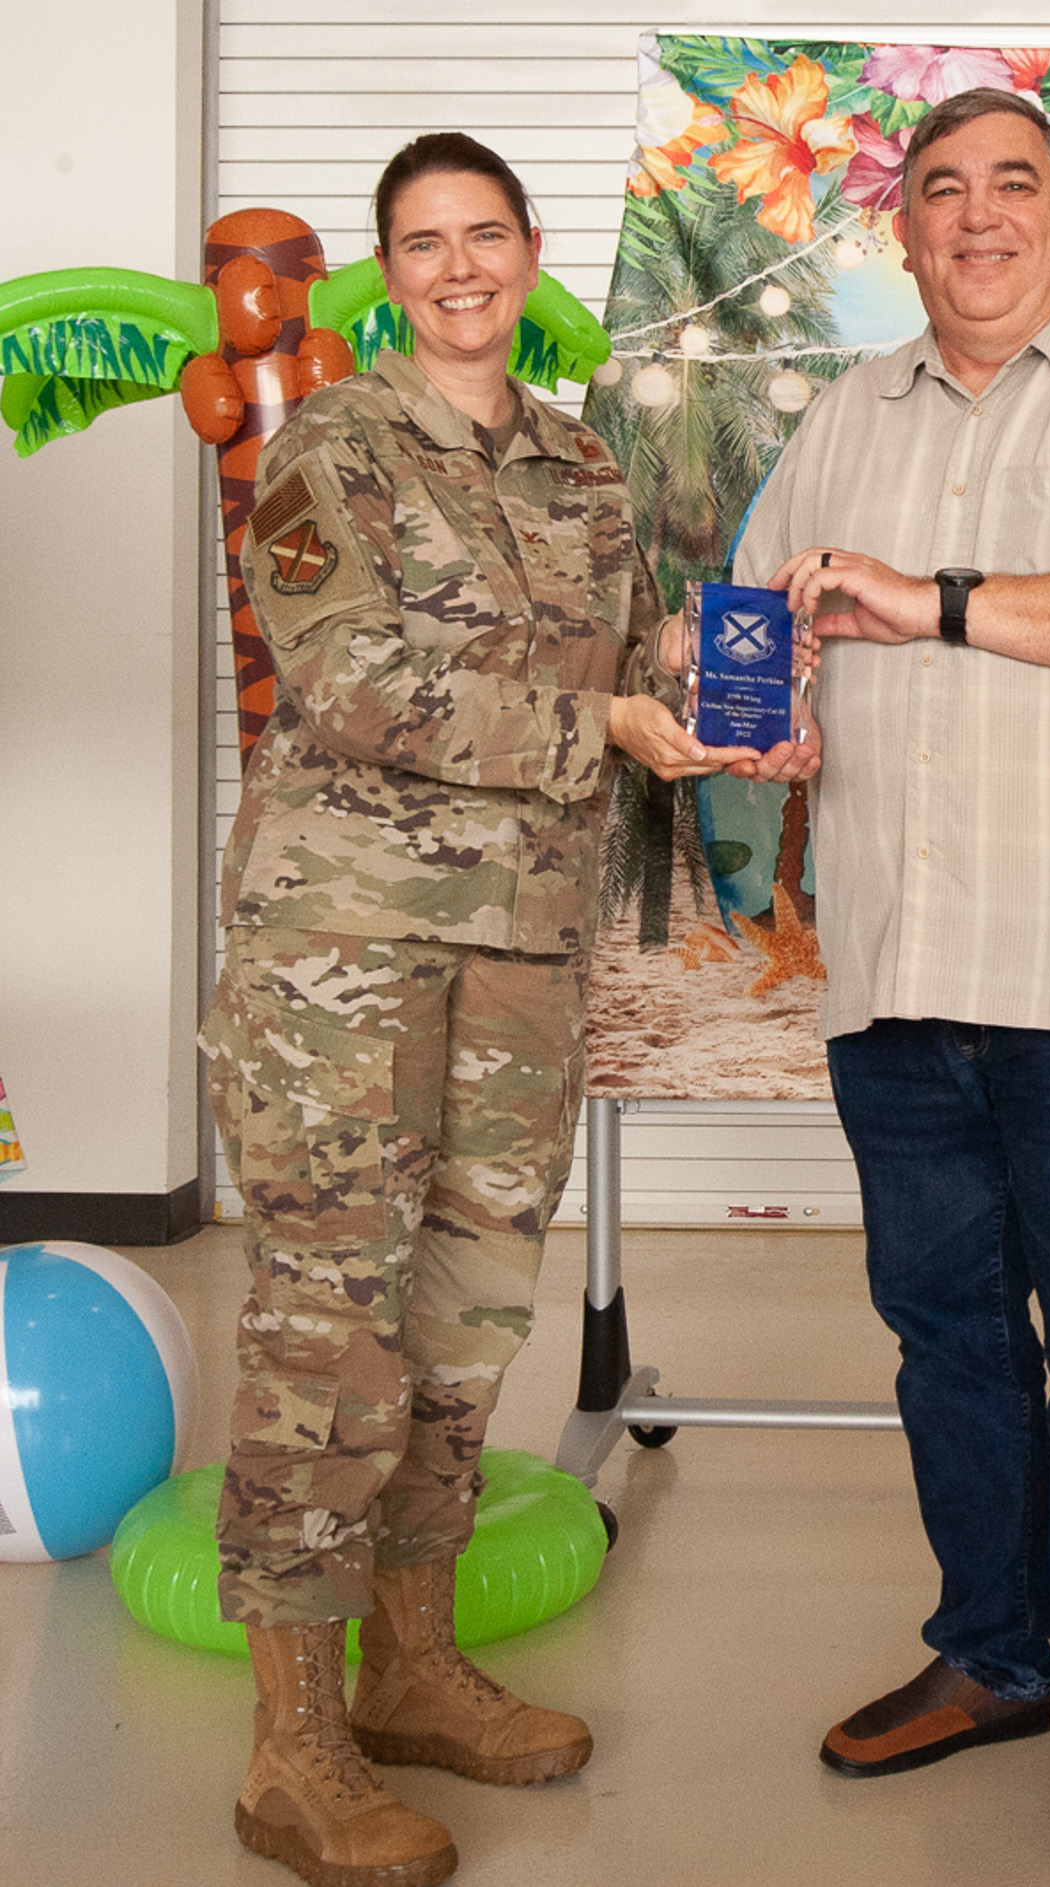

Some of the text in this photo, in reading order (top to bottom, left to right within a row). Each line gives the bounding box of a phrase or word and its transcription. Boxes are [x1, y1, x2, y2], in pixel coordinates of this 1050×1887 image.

[720, 672, 755, 682] Samantha
[757, 676, 784, 685] Perkins
[743, 694, 762, 703] Wing
